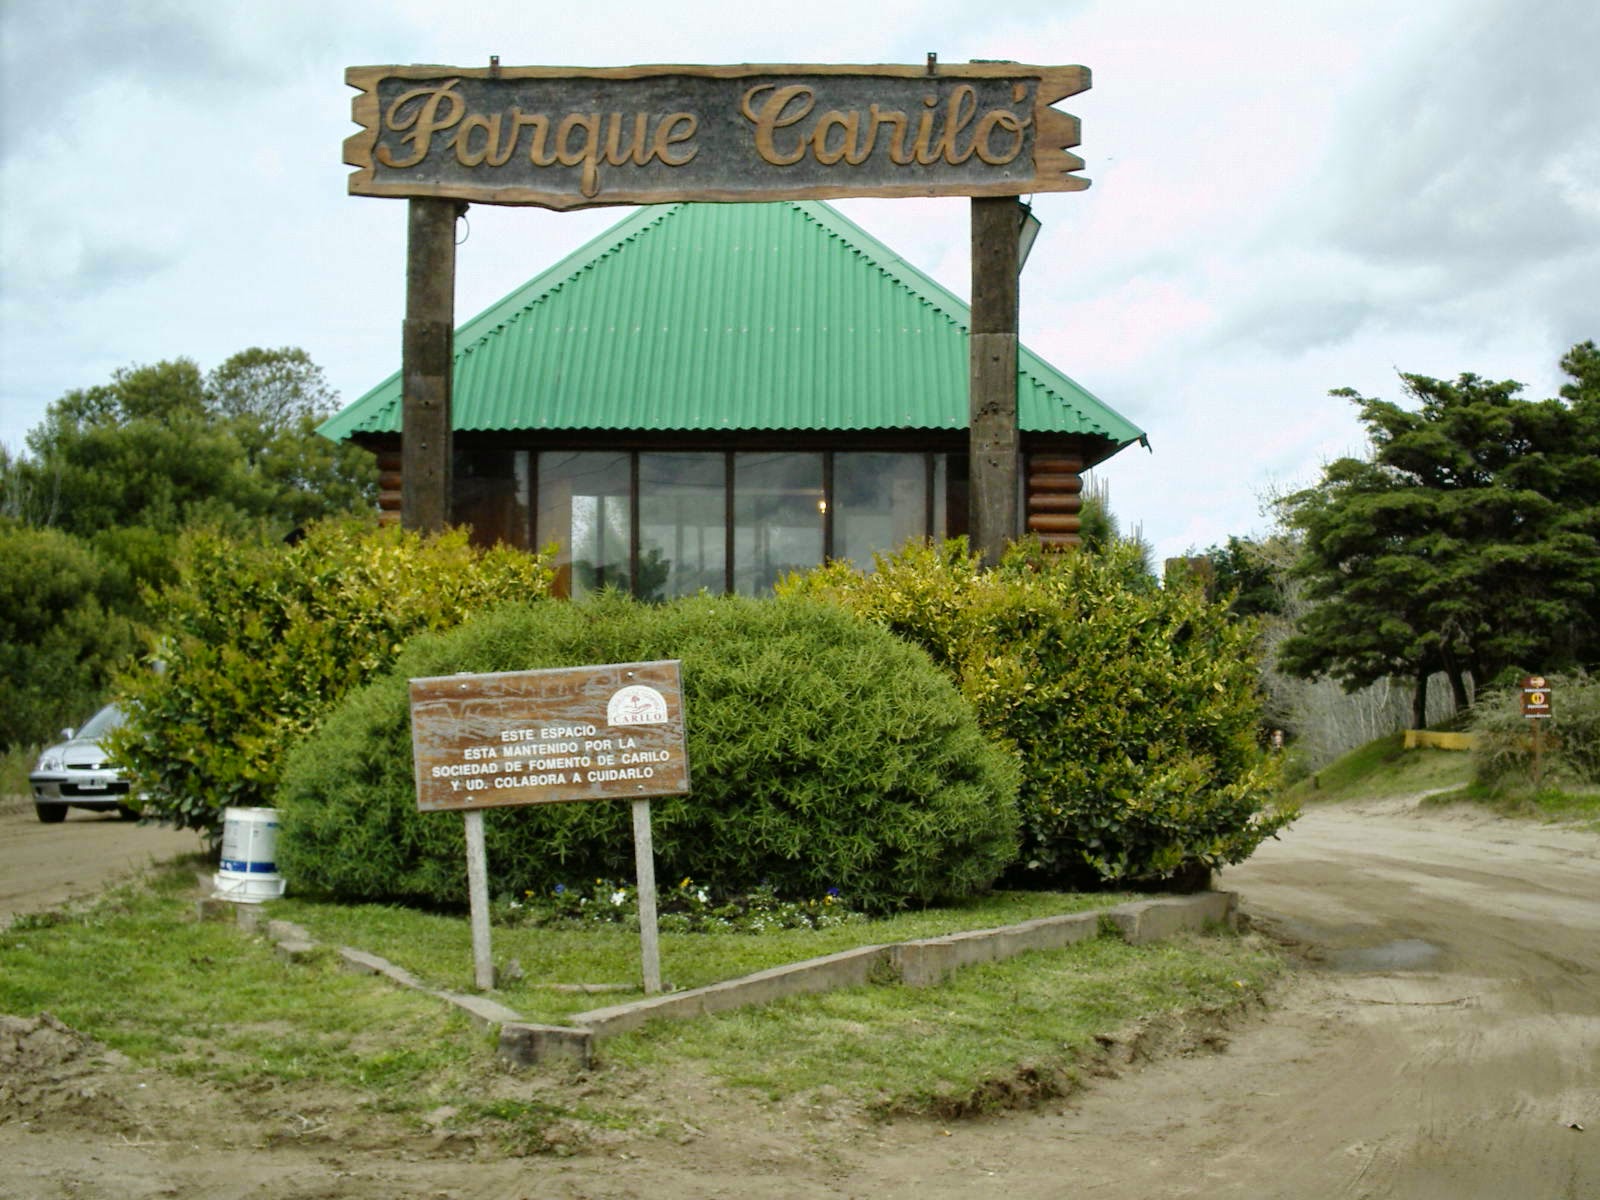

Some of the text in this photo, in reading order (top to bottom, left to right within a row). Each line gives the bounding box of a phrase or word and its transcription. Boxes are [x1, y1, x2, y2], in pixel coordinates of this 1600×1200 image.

[375, 79, 700, 197] Parque
[501, 725, 596, 742] ESTE ESPACIO
[464, 739, 636, 760] ESTA MANTENIDO POR LA
[432, 750, 670, 778] SOCIEDAD DE FOMENTO DE CARILO
[451, 767, 654, 792] Y UD. COLABORA A CUIDARLO
